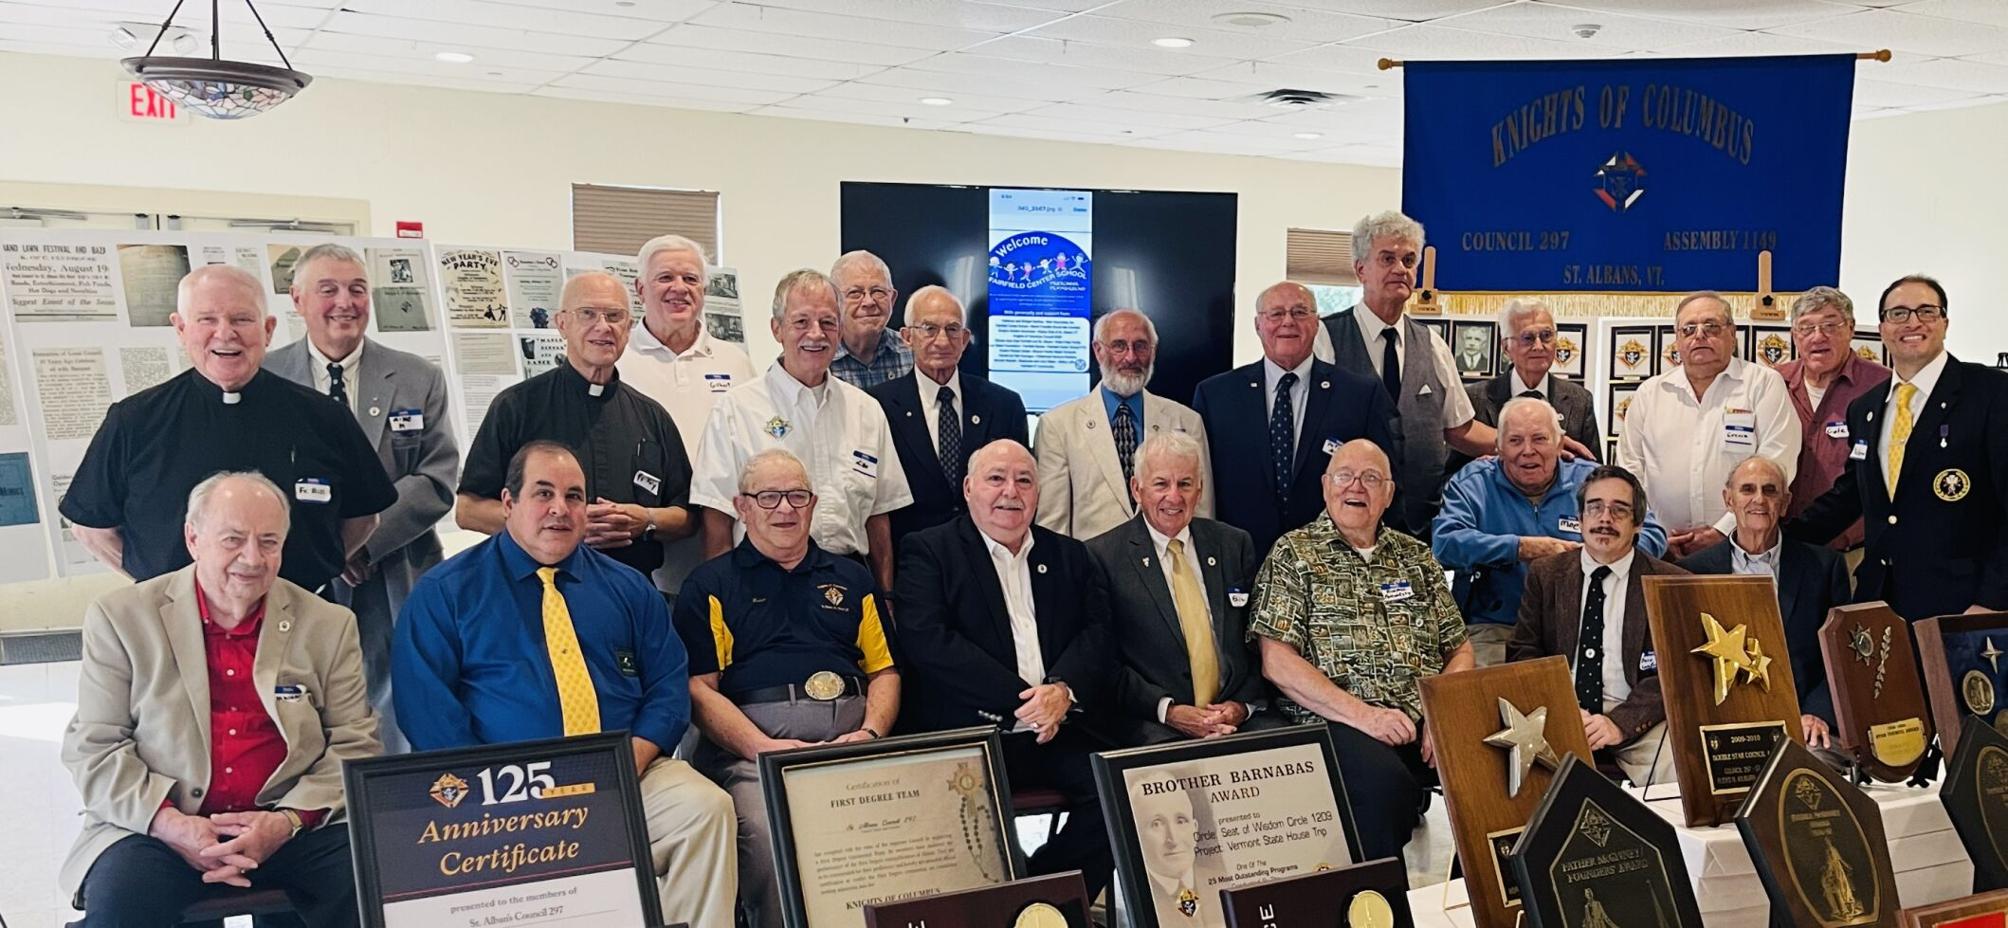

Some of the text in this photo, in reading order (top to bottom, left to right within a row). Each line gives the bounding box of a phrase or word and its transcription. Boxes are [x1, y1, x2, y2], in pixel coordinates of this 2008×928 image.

[1491, 83, 1754, 168] KNIGHTS OF COLUMBUS
[43, 244, 71, 254] FESTIVAL
[995, 235, 1049, 258] Welcome
[1461, 230, 1570, 252] COUNCIL 297
[1663, 230, 1777, 251] ASSEMBLY 1149
[60, 263, 94, 273] August
[441, 255, 457, 266] NEW
[453, 260, 487, 270] PARTY
[988, 269, 1088, 289] FAIRFIELD CENTER SCHOOL
[1563, 264, 1665, 287] ST. ALBANS, VT.
[476, 761, 555, 806] 125
[1141, 760, 1315, 796] BROTHER BARNABAS
[830, 789, 920, 809] FIRST DEGREE TEAM
[1210, 786, 1261, 804] AWARD
[416, 806, 589, 845] Anniversary
[1217, 811, 1261, 826] presented to
[1220, 826, 1240, 838] Seat
[1242, 824, 1251, 835] of
[1252, 820, 1285, 833] Wisdom
[1286, 815, 1309, 828] Circle
[1226, 838, 1262, 852] Vermont
[1263, 833, 1285, 846] State
[1286, 830, 1311, 842] House
[1312, 827, 1328, 838] Trip
[440, 840, 580, 876] Certificate
[1236, 863, 1248, 871] One
[1561, 857, 1597, 873] FATHER
[1217, 876, 1234, 884] Most
[1234, 869, 1270, 880] Outstanding
[1270, 864, 1298, 874] Programs
[450, 885, 578, 915] presented to the members of
[514, 908, 548, 921] Council
[548, 905, 564, 917] 297
